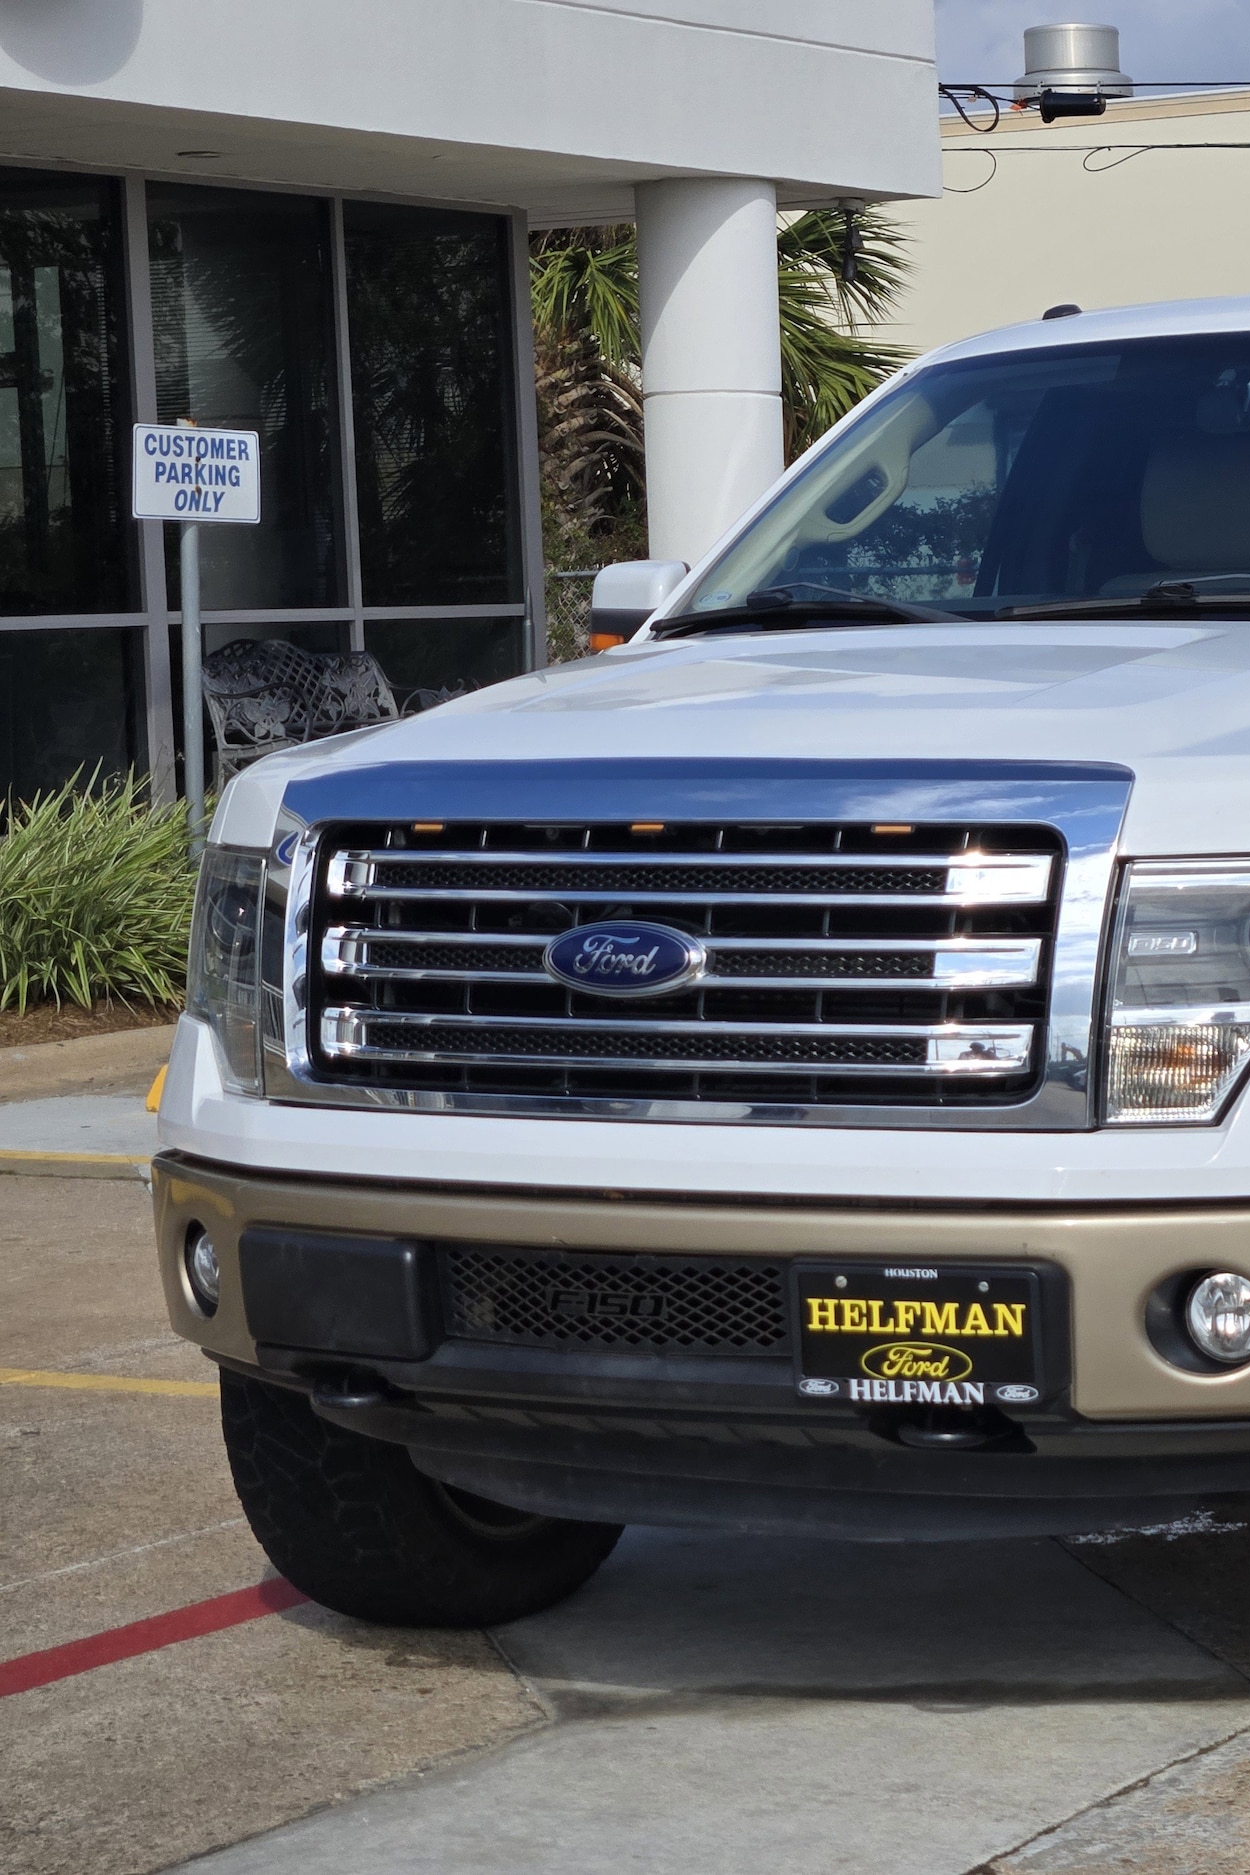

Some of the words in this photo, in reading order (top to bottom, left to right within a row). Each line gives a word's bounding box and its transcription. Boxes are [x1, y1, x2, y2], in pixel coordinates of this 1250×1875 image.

[144, 433, 250, 461] CUSTOMER
[154, 461, 241, 487] PARKING
[174, 489, 226, 513] ONLY
[573, 934, 660, 976] Ford
[884, 1268, 938, 1279] HOUSTON
[806, 1298, 1026, 1336] HELFMAN
[882, 1346, 950, 1378] Ford
[850, 1378, 985, 1404] HELFMAN
